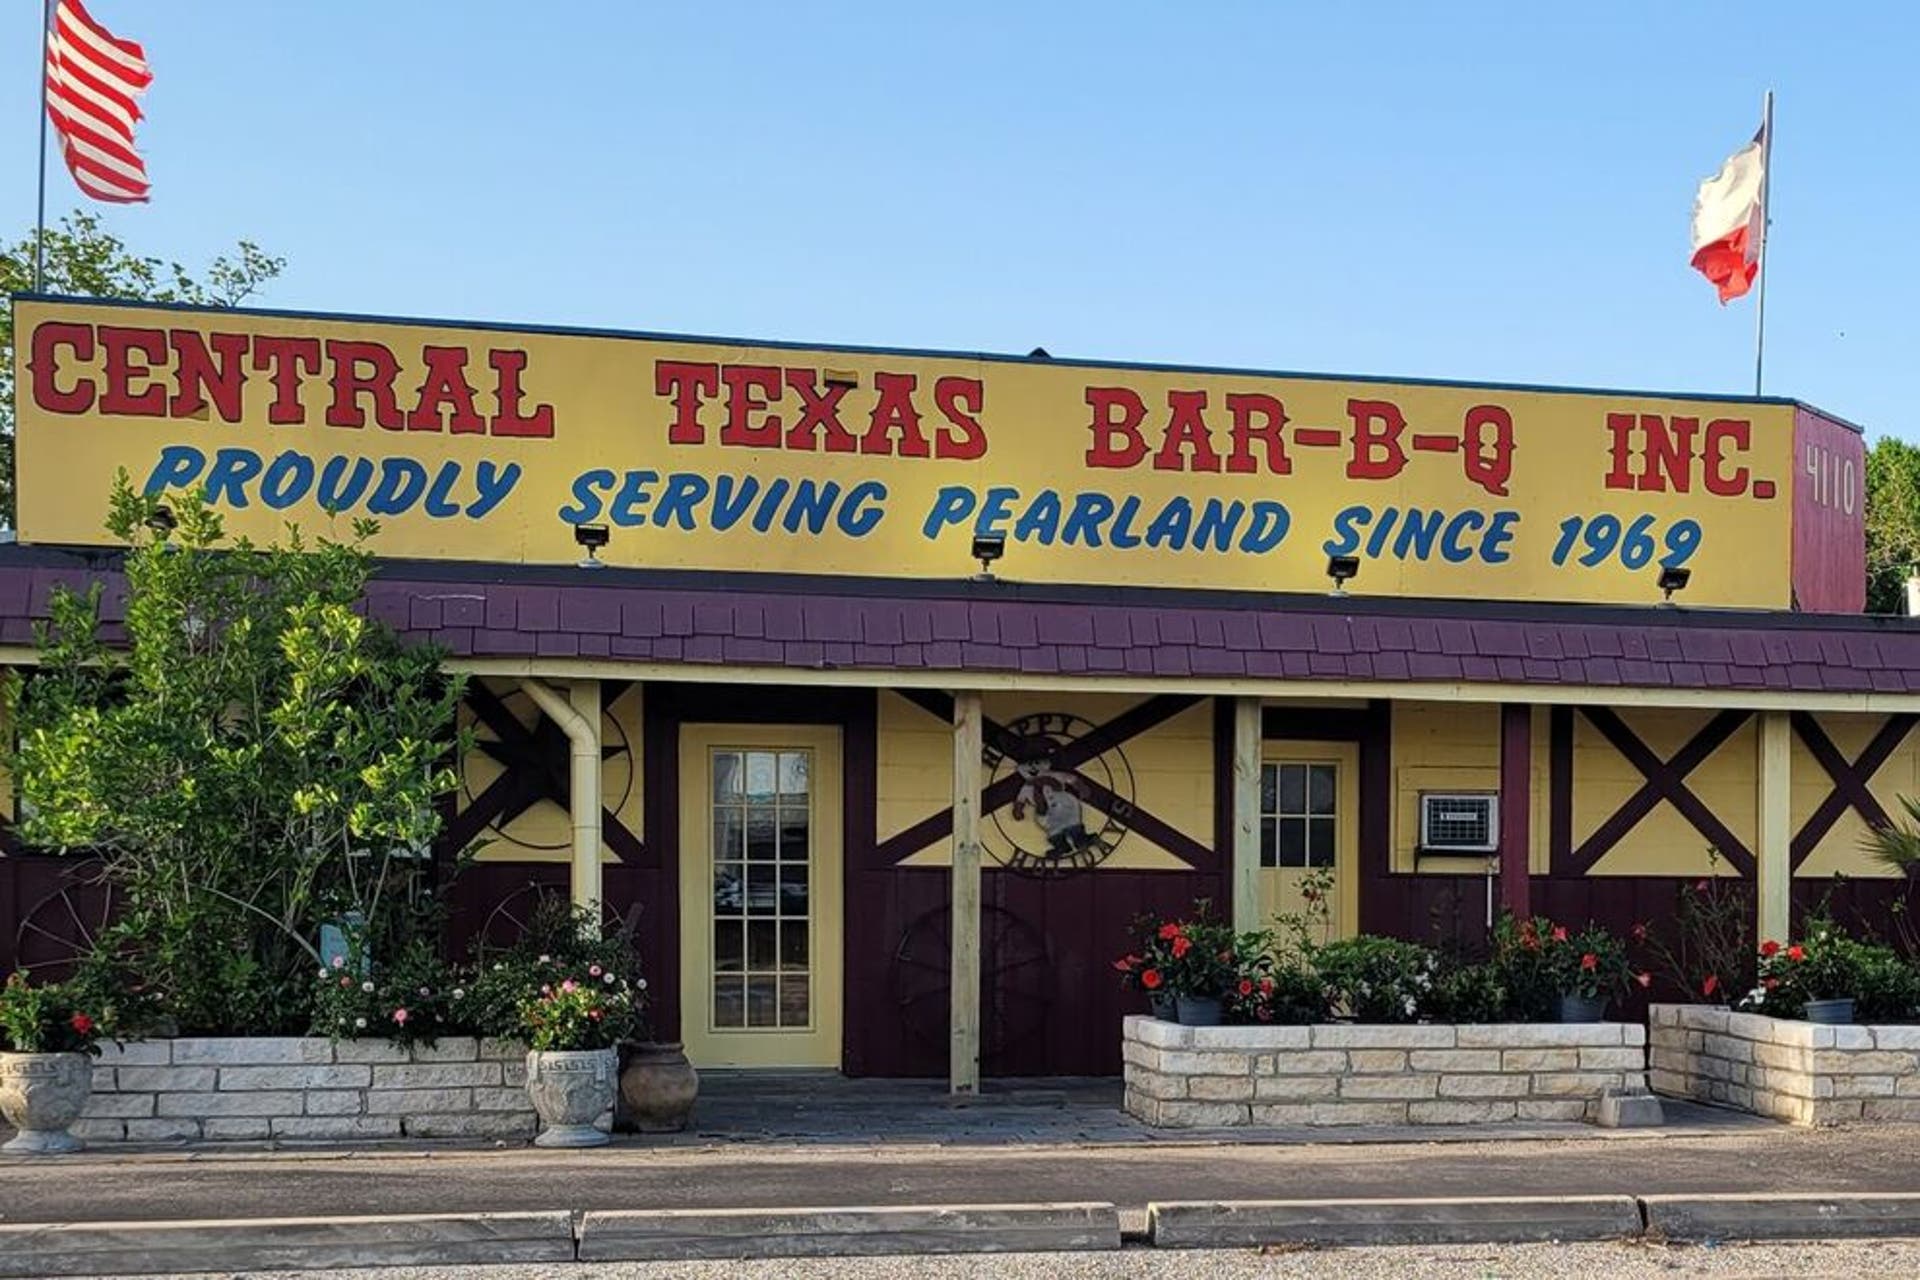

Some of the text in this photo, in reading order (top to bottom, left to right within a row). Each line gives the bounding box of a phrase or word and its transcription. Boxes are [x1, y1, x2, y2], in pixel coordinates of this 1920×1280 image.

[27, 321, 1776, 499] CENTRAL TEXAS BAR-B-Q INC.
[141, 446, 1702, 571] PROUDLY SERVING PEARLAND SINCE 1969
[1805, 444, 1855, 515] 4110
